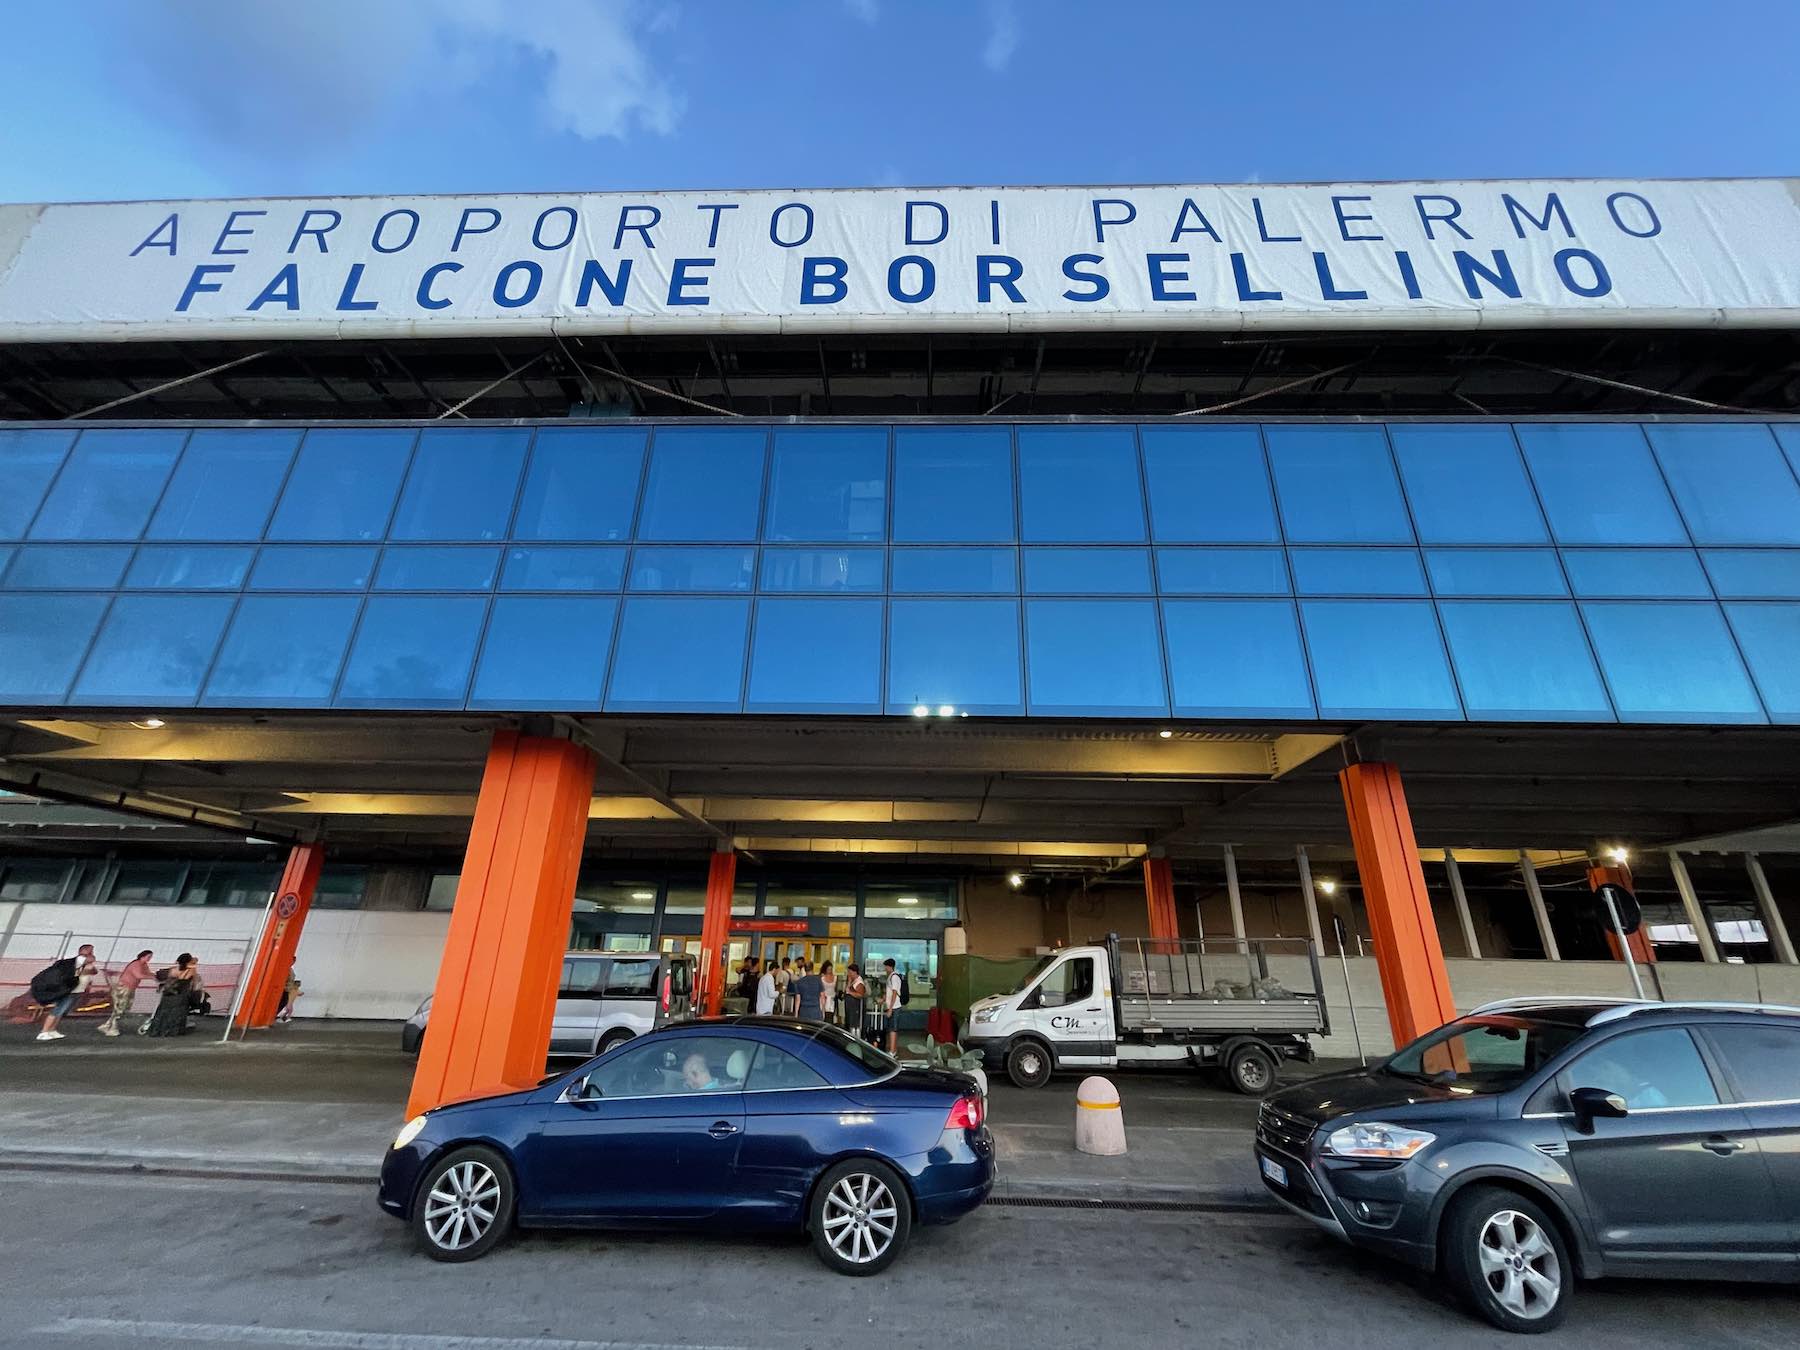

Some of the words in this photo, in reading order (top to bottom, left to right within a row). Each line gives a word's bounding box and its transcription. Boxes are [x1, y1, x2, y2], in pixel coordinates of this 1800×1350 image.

[129, 203, 814, 256] AEROPORTO
[905, 200, 1000, 246] DI
[1093, 191, 1662, 243] PALERMO
[174, 257, 717, 312] FALCONE
[799, 247, 1613, 304] BORSELLINO
